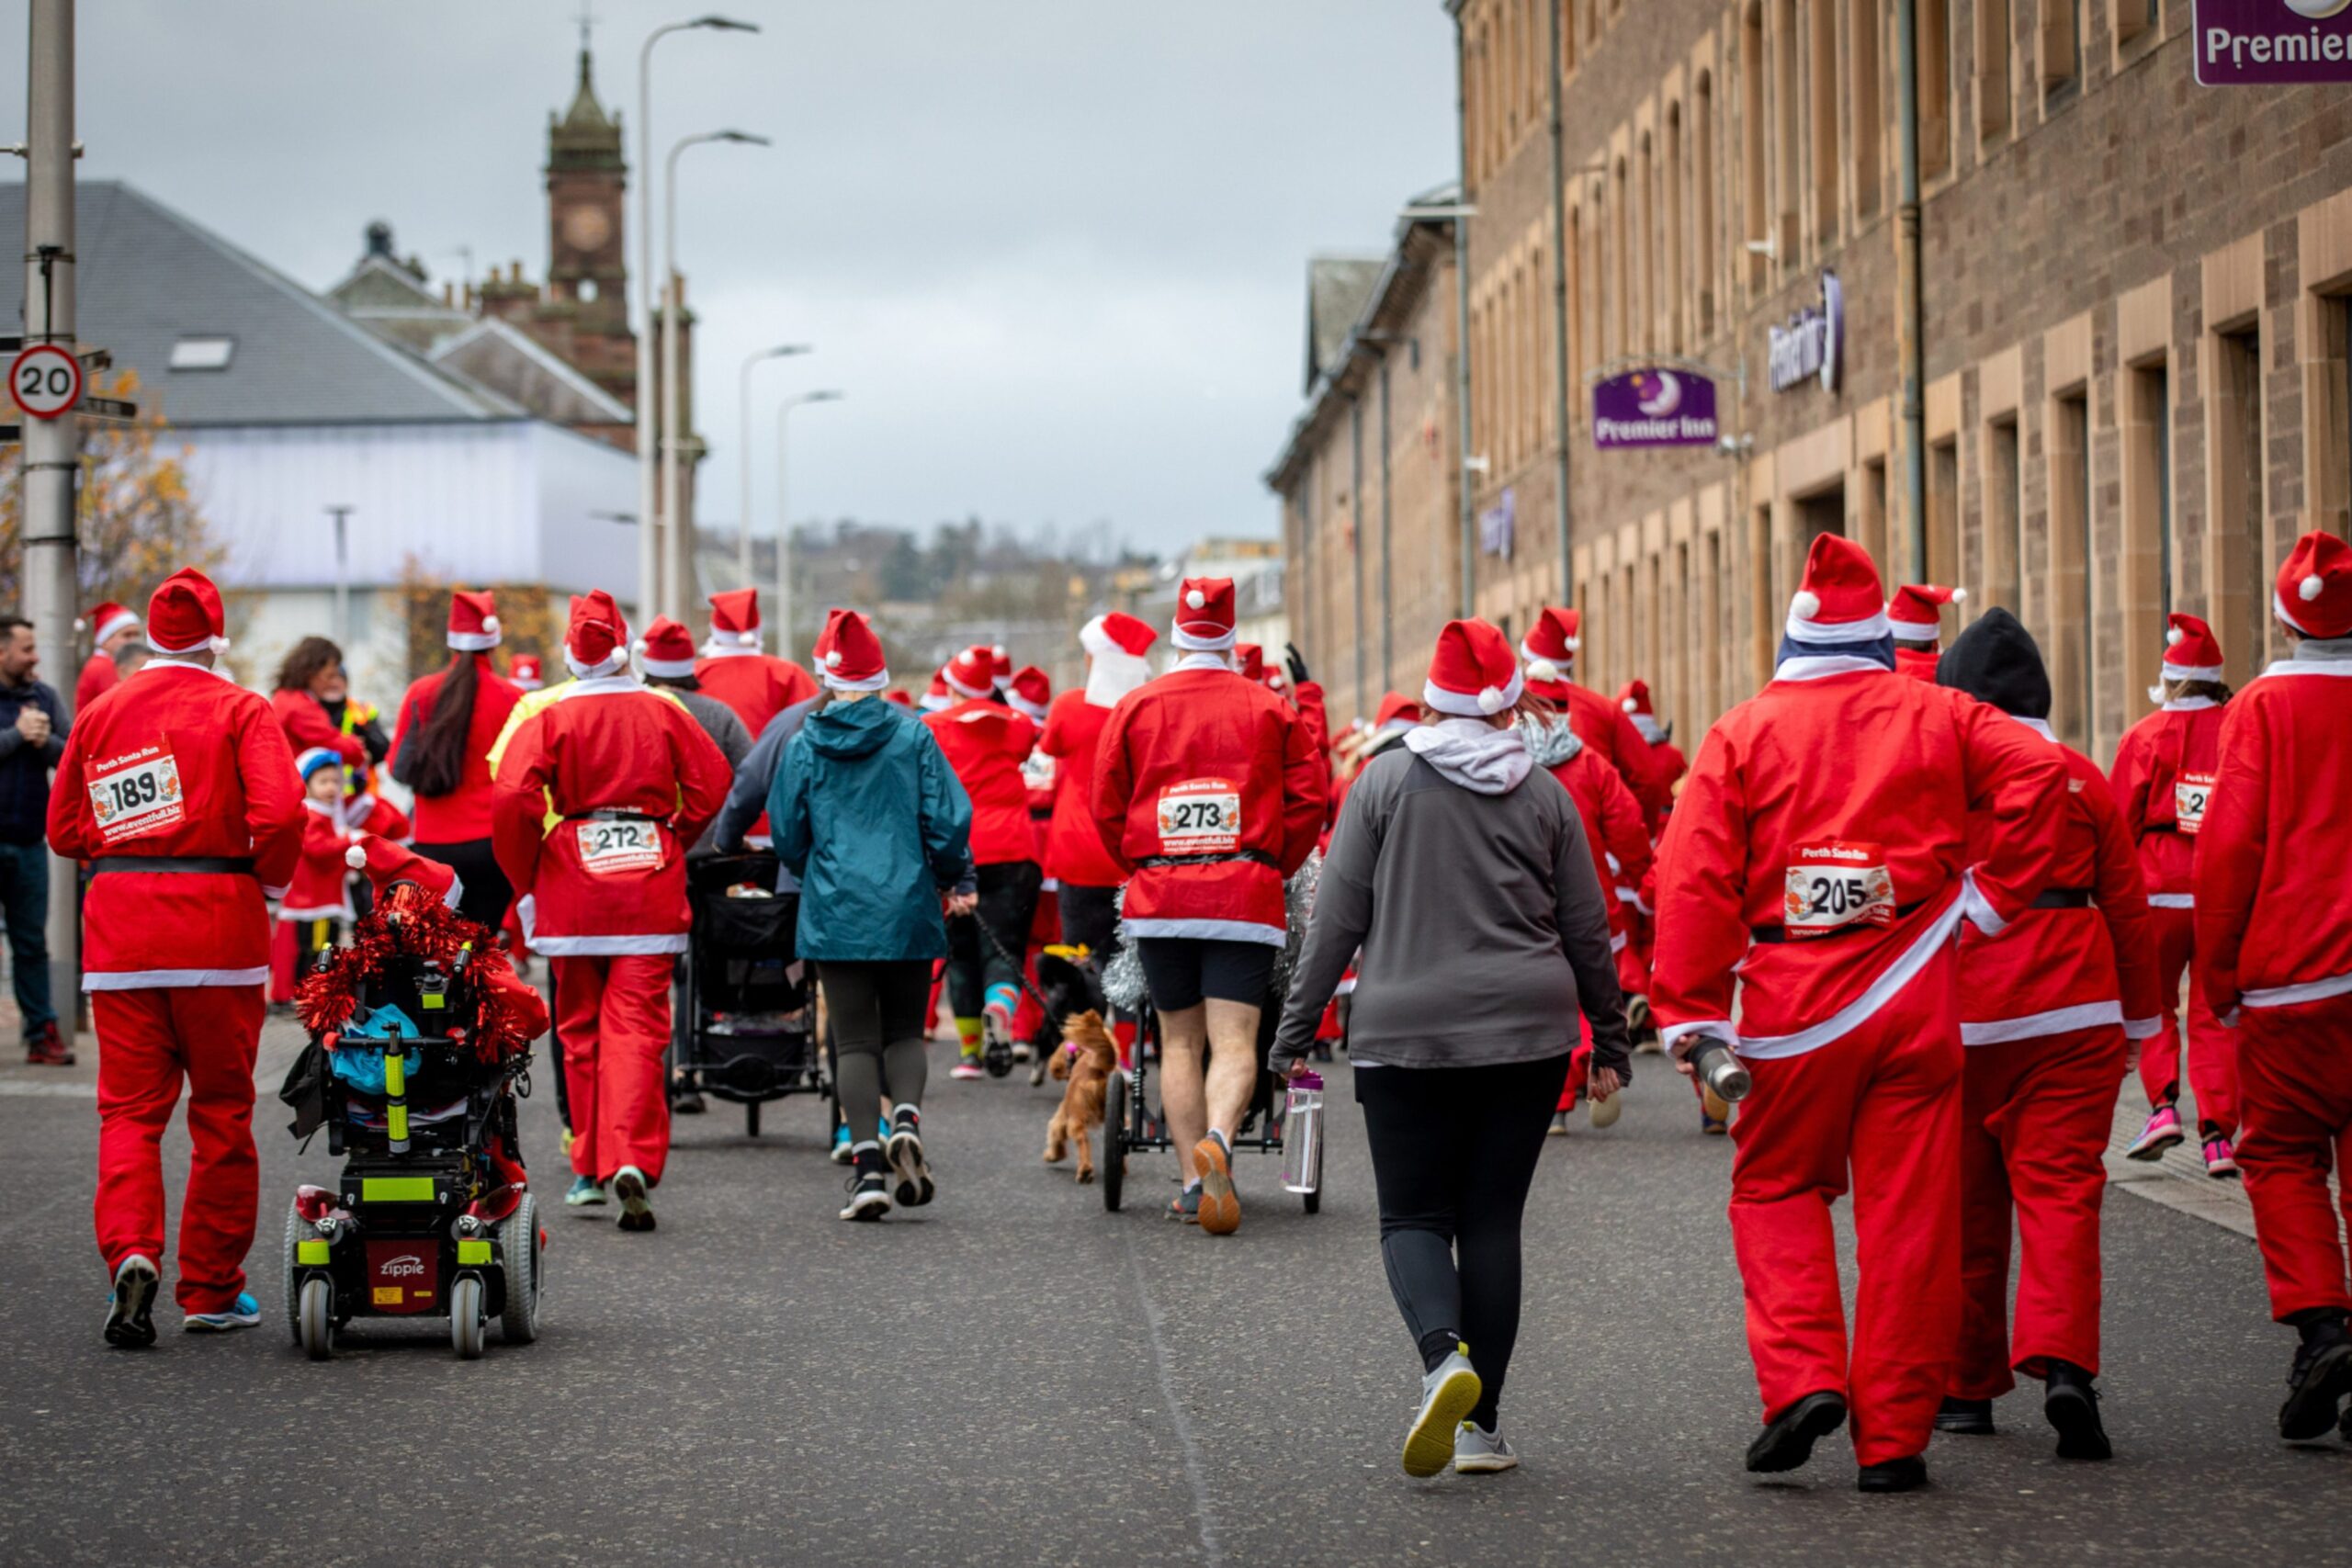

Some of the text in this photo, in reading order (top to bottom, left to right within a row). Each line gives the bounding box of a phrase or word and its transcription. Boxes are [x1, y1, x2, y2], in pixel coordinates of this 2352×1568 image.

[22, 367, 70, 397] 20
[1596, 414, 1715, 442] Premier Inn
[96, 746, 160, 773] Perth Santa Run
[110, 772, 156, 812] 189
[104, 805, 180, 837] www.eventfull.biz
[1177, 802, 1221, 828] 273
[597, 826, 640, 849] 272
[1802, 847, 1831, 858] Perth
[1812, 876, 1867, 915] 205
[380, 1262, 424, 1278] zippie
